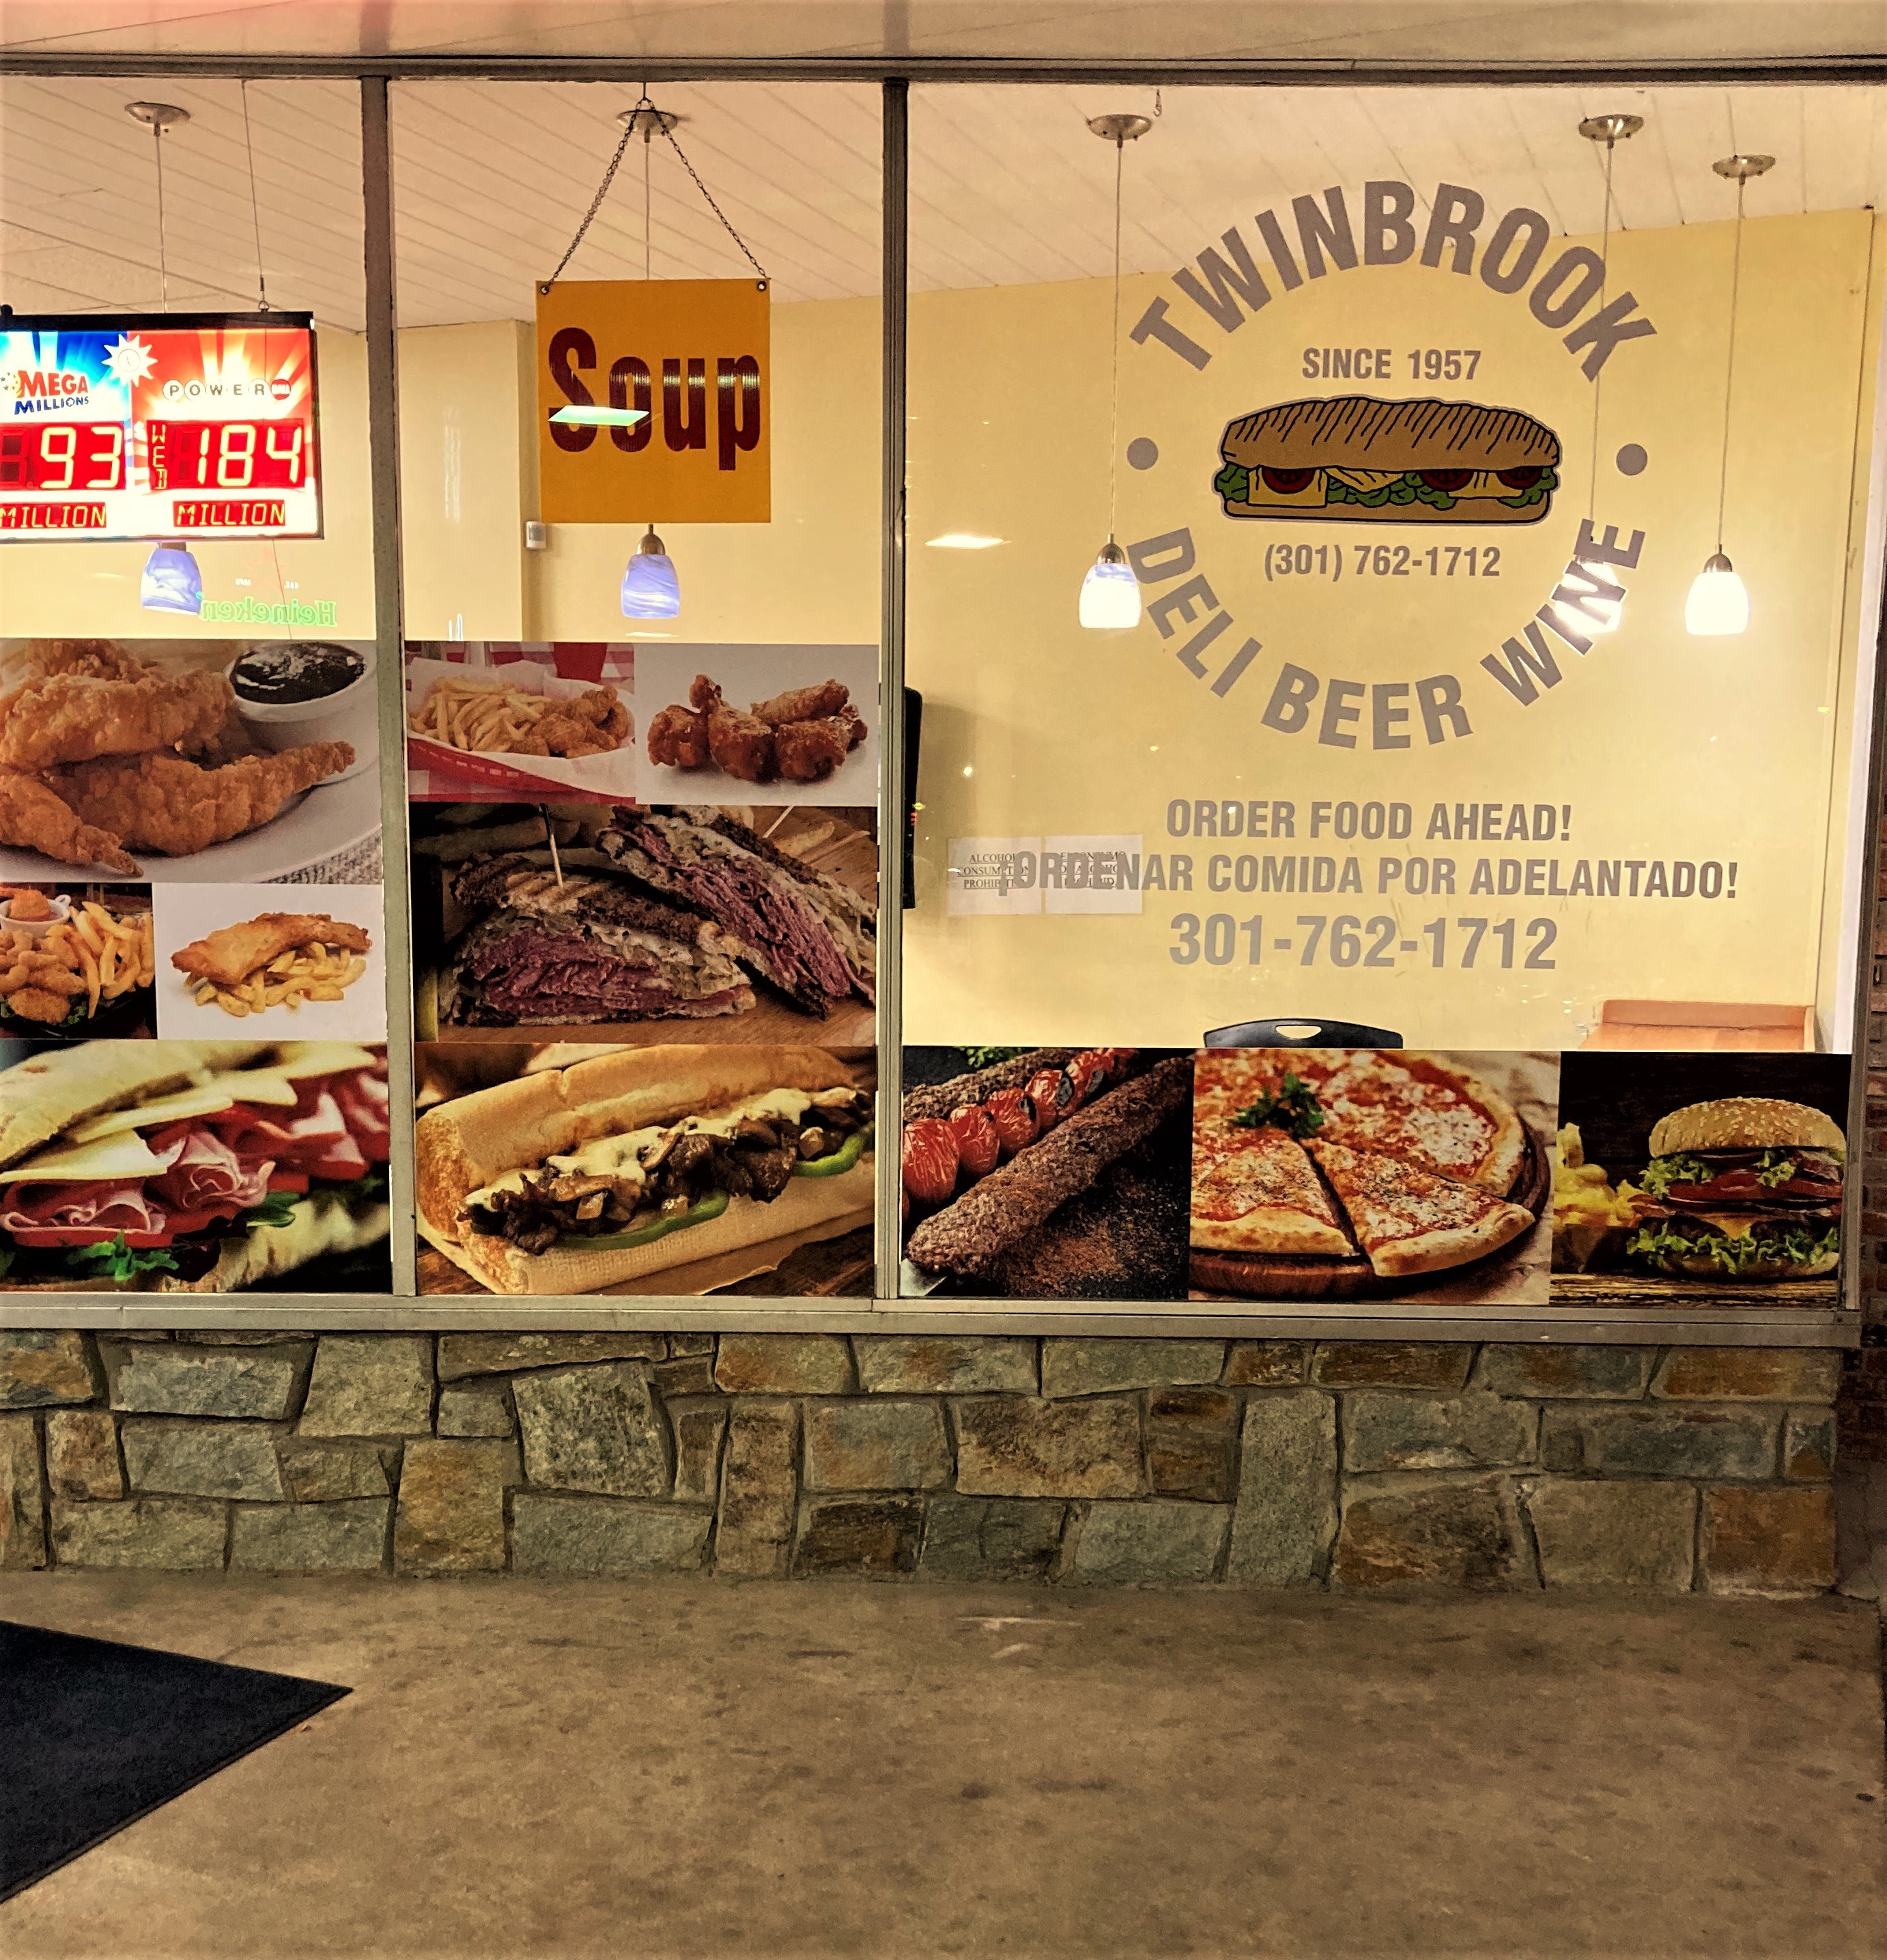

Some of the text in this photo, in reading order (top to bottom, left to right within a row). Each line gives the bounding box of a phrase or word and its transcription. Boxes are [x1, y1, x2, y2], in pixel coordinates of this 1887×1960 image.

[1129, 181, 1658, 382] TWINBROOK
[17, 370, 89, 398] MEGA
[1303, 348, 1481, 380] SINCE 1957
[14, 396, 89, 415] MILLIONS
[548, 327, 761, 470] Soup
[40, 427, 122, 489] 93
[197, 425, 302, 487] 184
[0, 506, 105, 528] MILLION
[178, 503, 285, 525] MILLION
[1264, 544, 1501, 582] (301) 762-1712
[1126, 519, 1646, 750] DELI BEER WINE
[1167, 799, 1571, 842] ORDER FOOD AHEAD!
[1208, 854, 1362, 894] COMIDA
[1378, 857, 1456, 895] POR
[1470, 858, 1737, 899] ADELANTADO!
[1169, 913, 1557, 969] 301-762-1712
